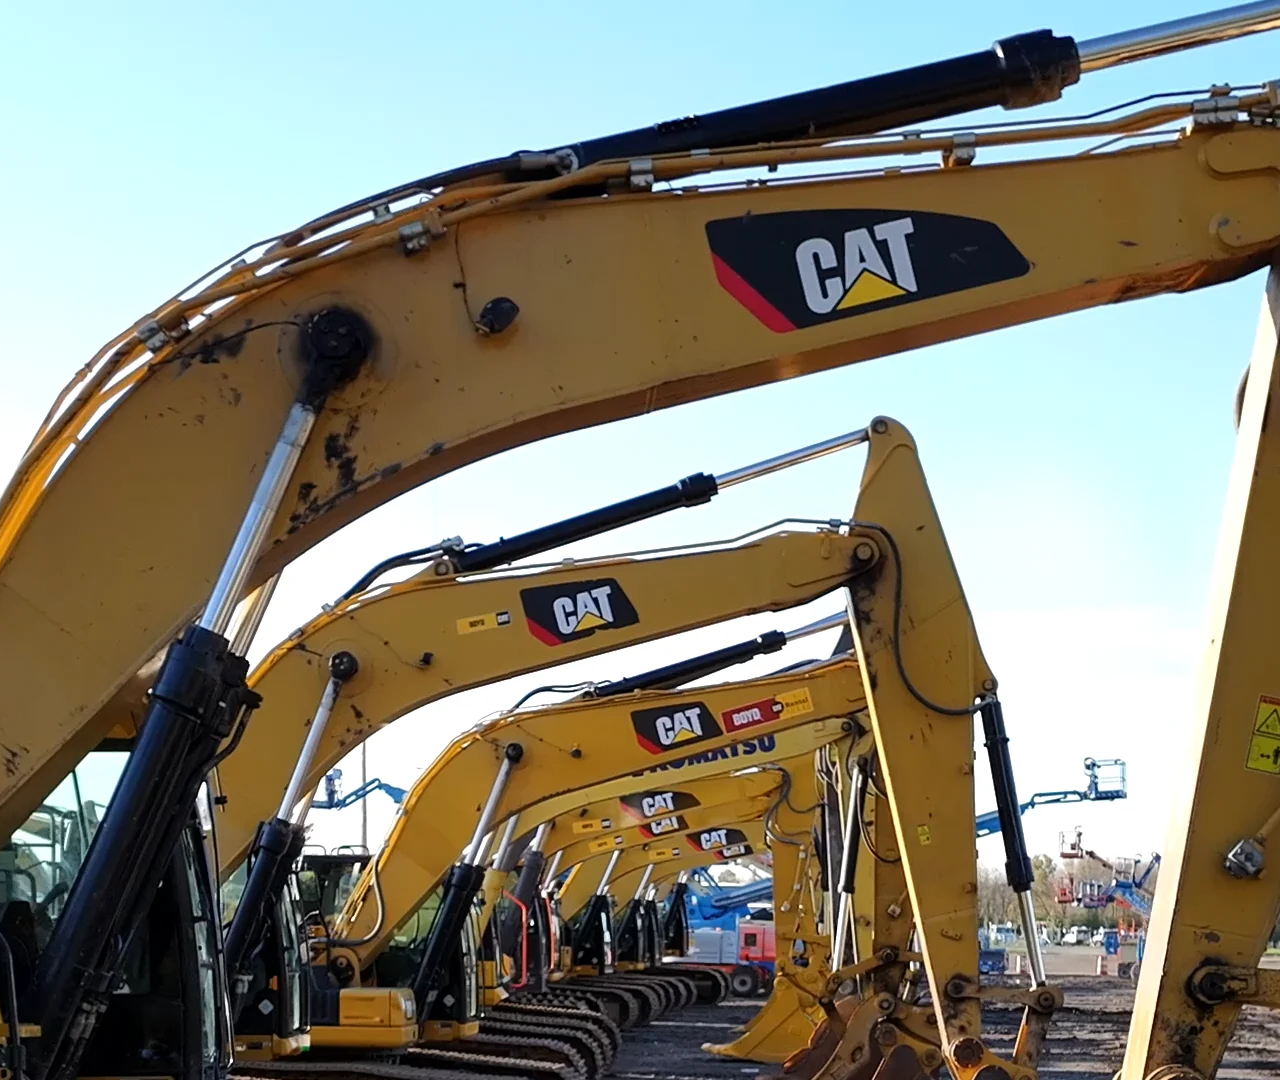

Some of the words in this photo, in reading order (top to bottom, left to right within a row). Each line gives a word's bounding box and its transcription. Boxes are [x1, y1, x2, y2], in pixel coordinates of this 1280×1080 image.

[795, 217, 918, 314] CAT
[553, 586, 615, 635] CAT
[655, 707, 703, 746] CAT
[732, 708, 762, 726] BOYD
[785, 697, 808, 708] Rental
[641, 792, 675, 817] CAT
[700, 829, 728, 850] CAT
